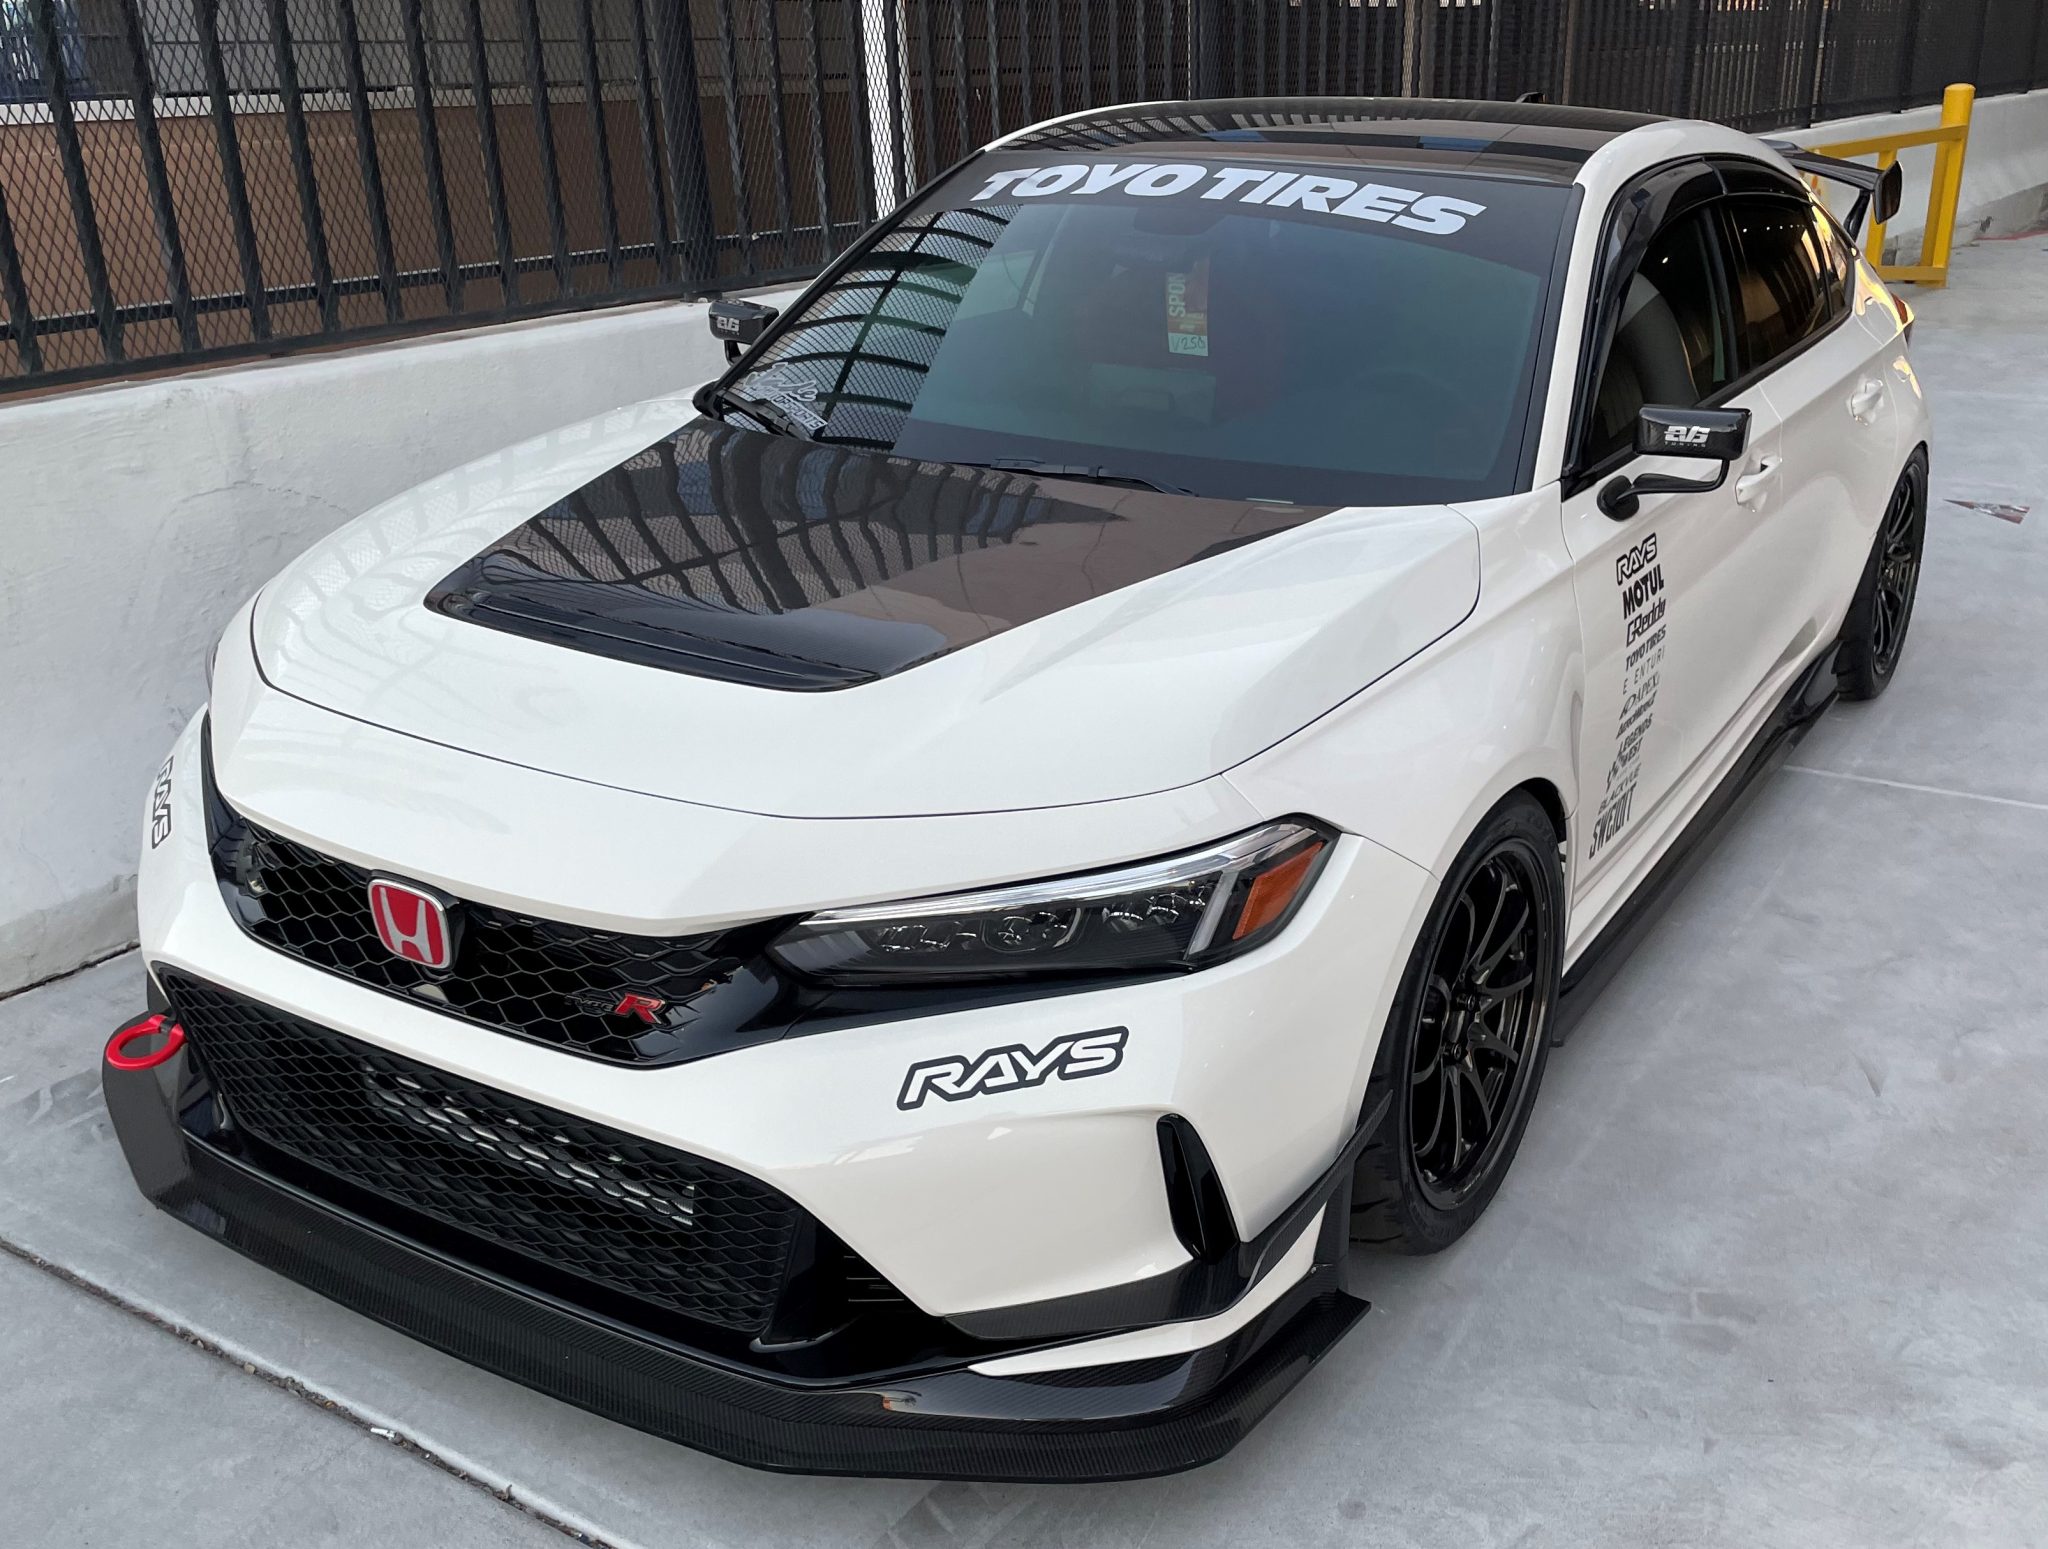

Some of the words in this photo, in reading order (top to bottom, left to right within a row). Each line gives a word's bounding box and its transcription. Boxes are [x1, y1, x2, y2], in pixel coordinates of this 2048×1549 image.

[970, 163, 1208, 202] TOYO
[1199, 167, 1488, 236] TIRES
[1616, 532, 1659, 586] RAYS
[1622, 563, 1665, 620] MOTUL
[1626, 596, 1668, 648] GReddy
[614, 992, 666, 1025] R
[896, 1015, 1130, 1112] RAYS
